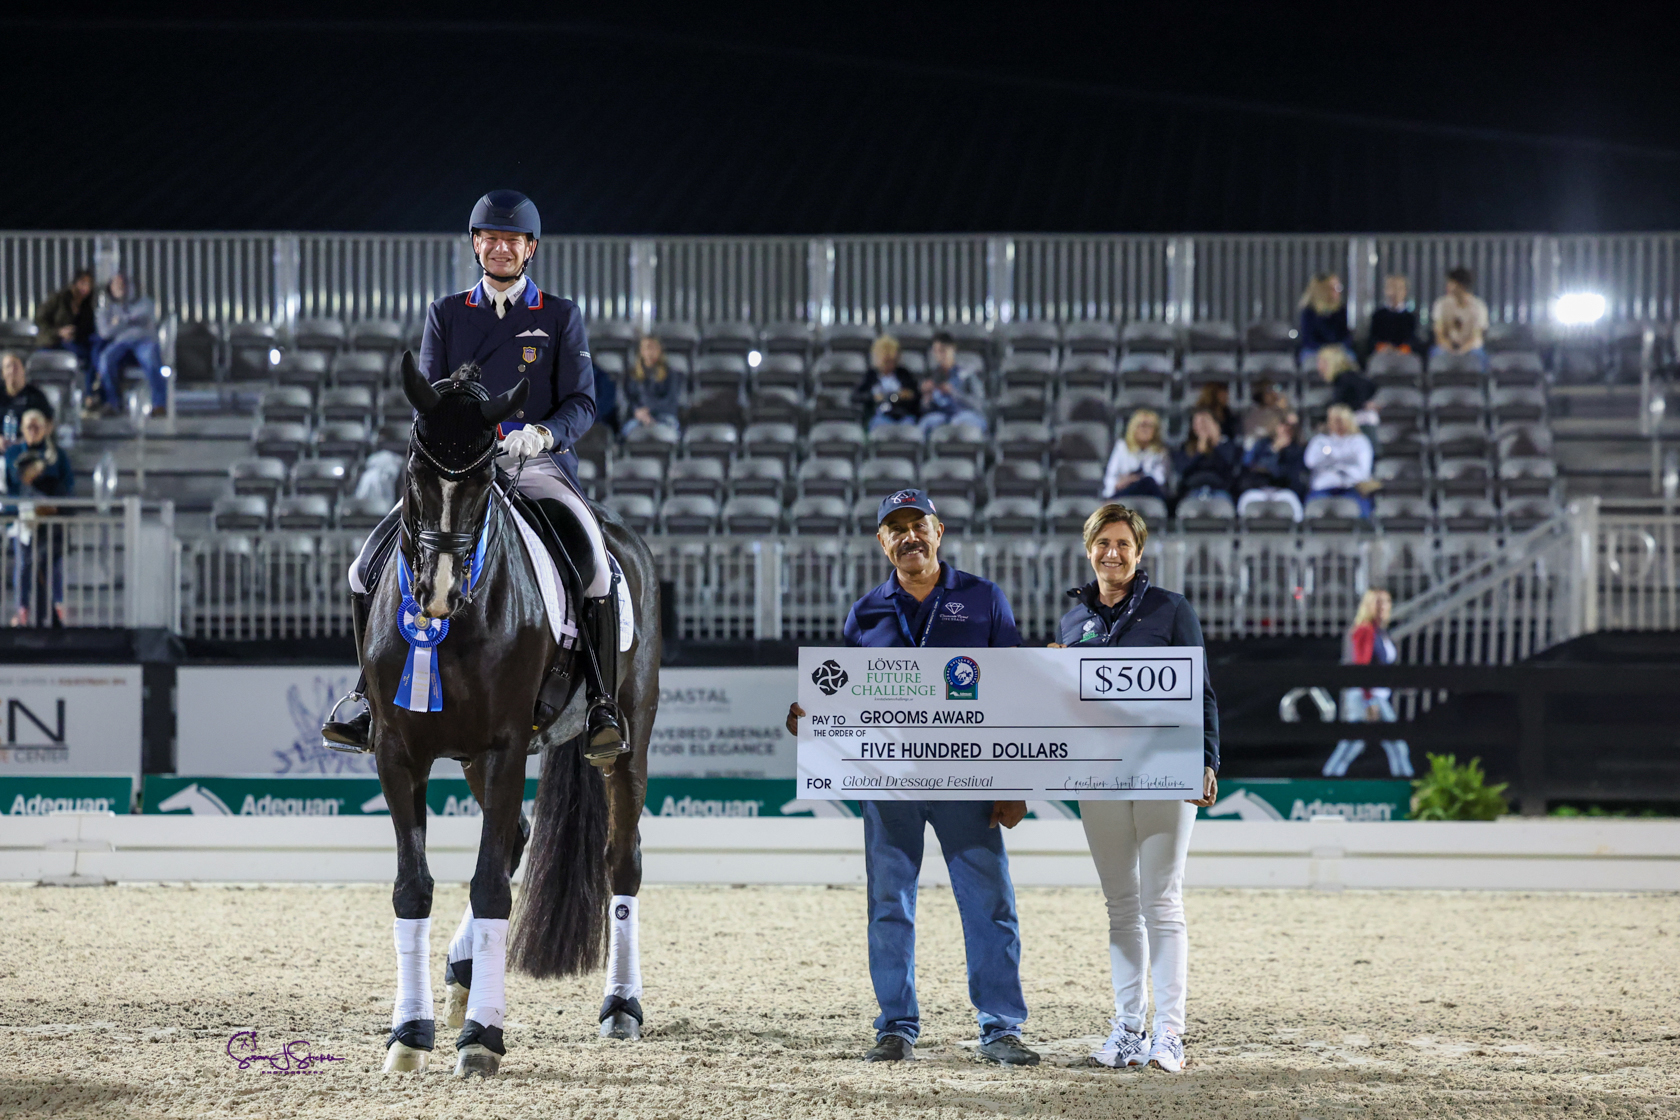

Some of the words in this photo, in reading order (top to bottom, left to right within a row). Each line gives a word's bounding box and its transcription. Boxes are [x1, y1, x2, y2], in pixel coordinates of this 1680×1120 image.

[867, 658, 920, 671] LÖVSTA
[866, 672, 922, 684] FUTURE
[1095, 665, 1177, 694] $500
[659, 687, 728, 703] OASTAL
[851, 685, 937, 696] CHALLENGE
[0, 698, 65, 742] N
[812, 715, 830, 726] PAY
[833, 715, 846, 726] TO
[860, 710, 928, 724] GROOMS
[932, 710, 985, 724] AWARD
[813, 729, 827, 737] THE
[828, 729, 854, 737] ORDER
[855, 729, 866, 737] OF
[861, 743, 896, 758] FIVE
[901, 743, 982, 758] HUNDRED
[992, 743, 1069, 758] DOLLARS
[806, 778, 832, 790] FOR
[842, 775, 883, 788] Global
[885, 775, 944, 790] Dressage
[946, 775, 994, 788] Festival
